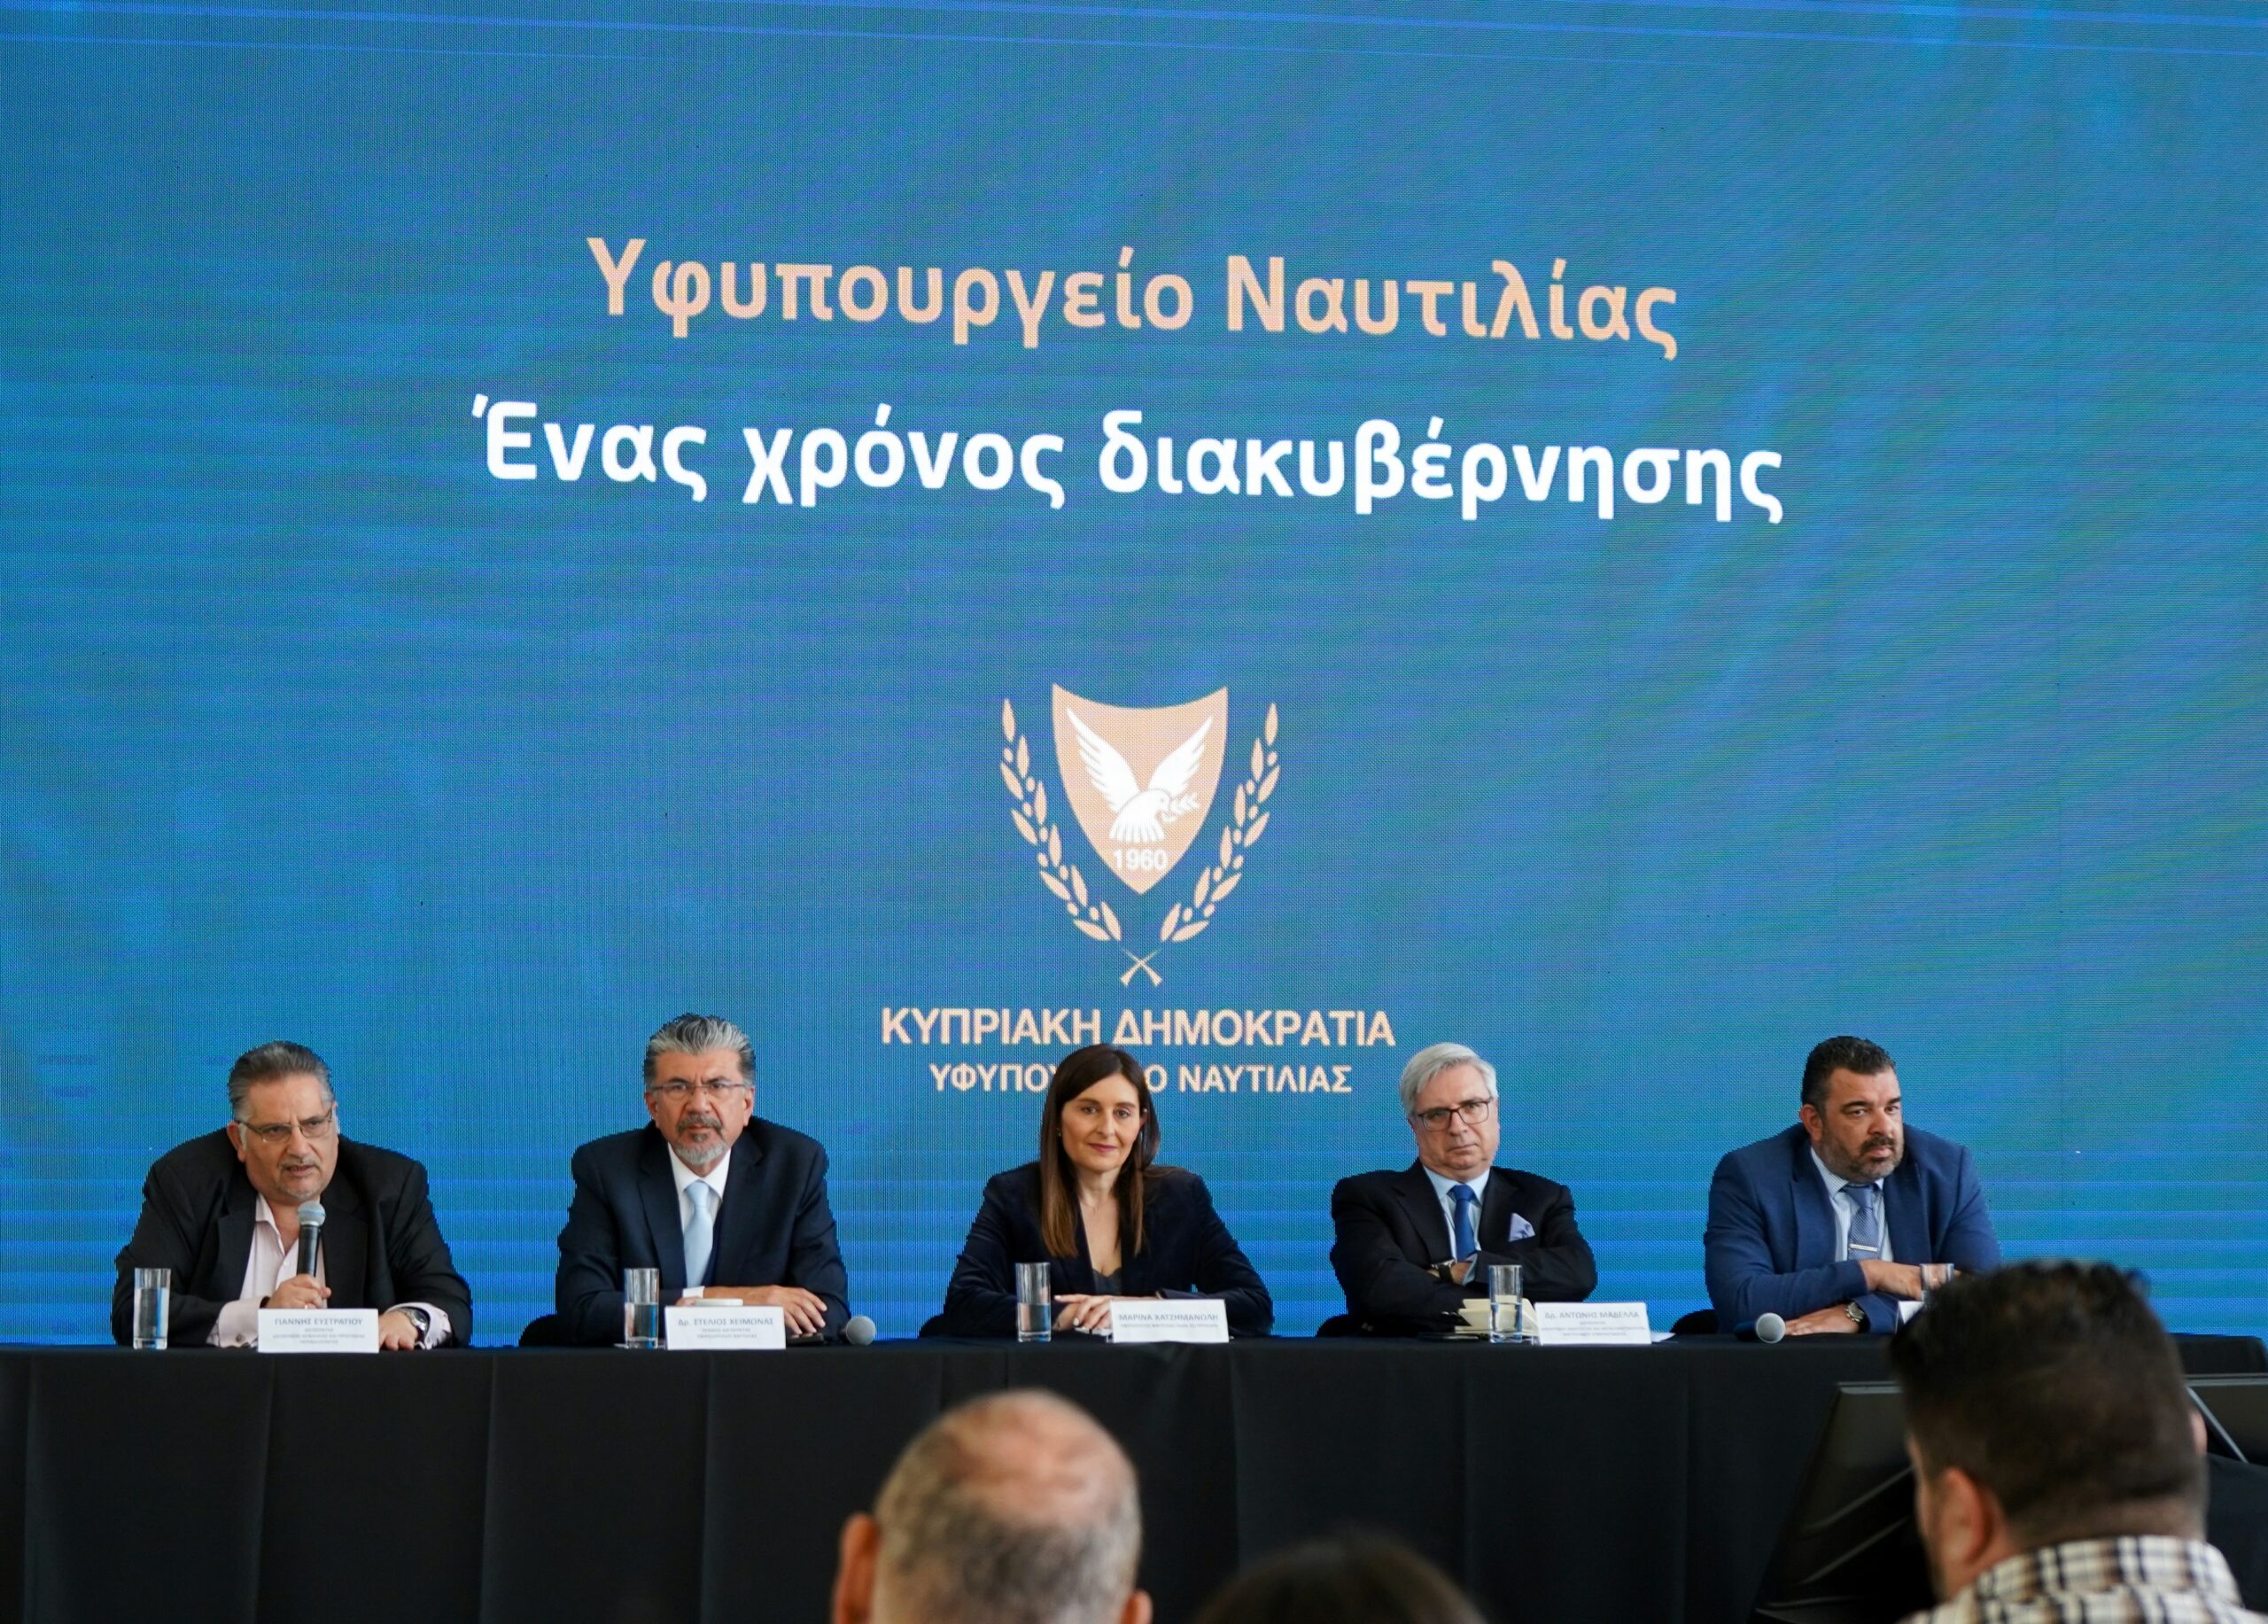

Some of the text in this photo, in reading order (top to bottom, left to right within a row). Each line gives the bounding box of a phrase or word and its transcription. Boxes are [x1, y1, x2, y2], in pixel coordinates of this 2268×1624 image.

[586, 237, 1677, 361] Υφυπουργείο Ναυτιλίας
[471, 393, 1783, 524] Ένας χρόνος διακυβέρνησης
[1113, 849, 1169, 872] 1960
[882, 1007, 1395, 1046] ΚΥΠΡΙΑΚΗ ΔΗΜΟΚΡΑΤΙΑ
[1179, 1064, 1352, 1094] ΝΑΥΤΙΛΙΑΣ
